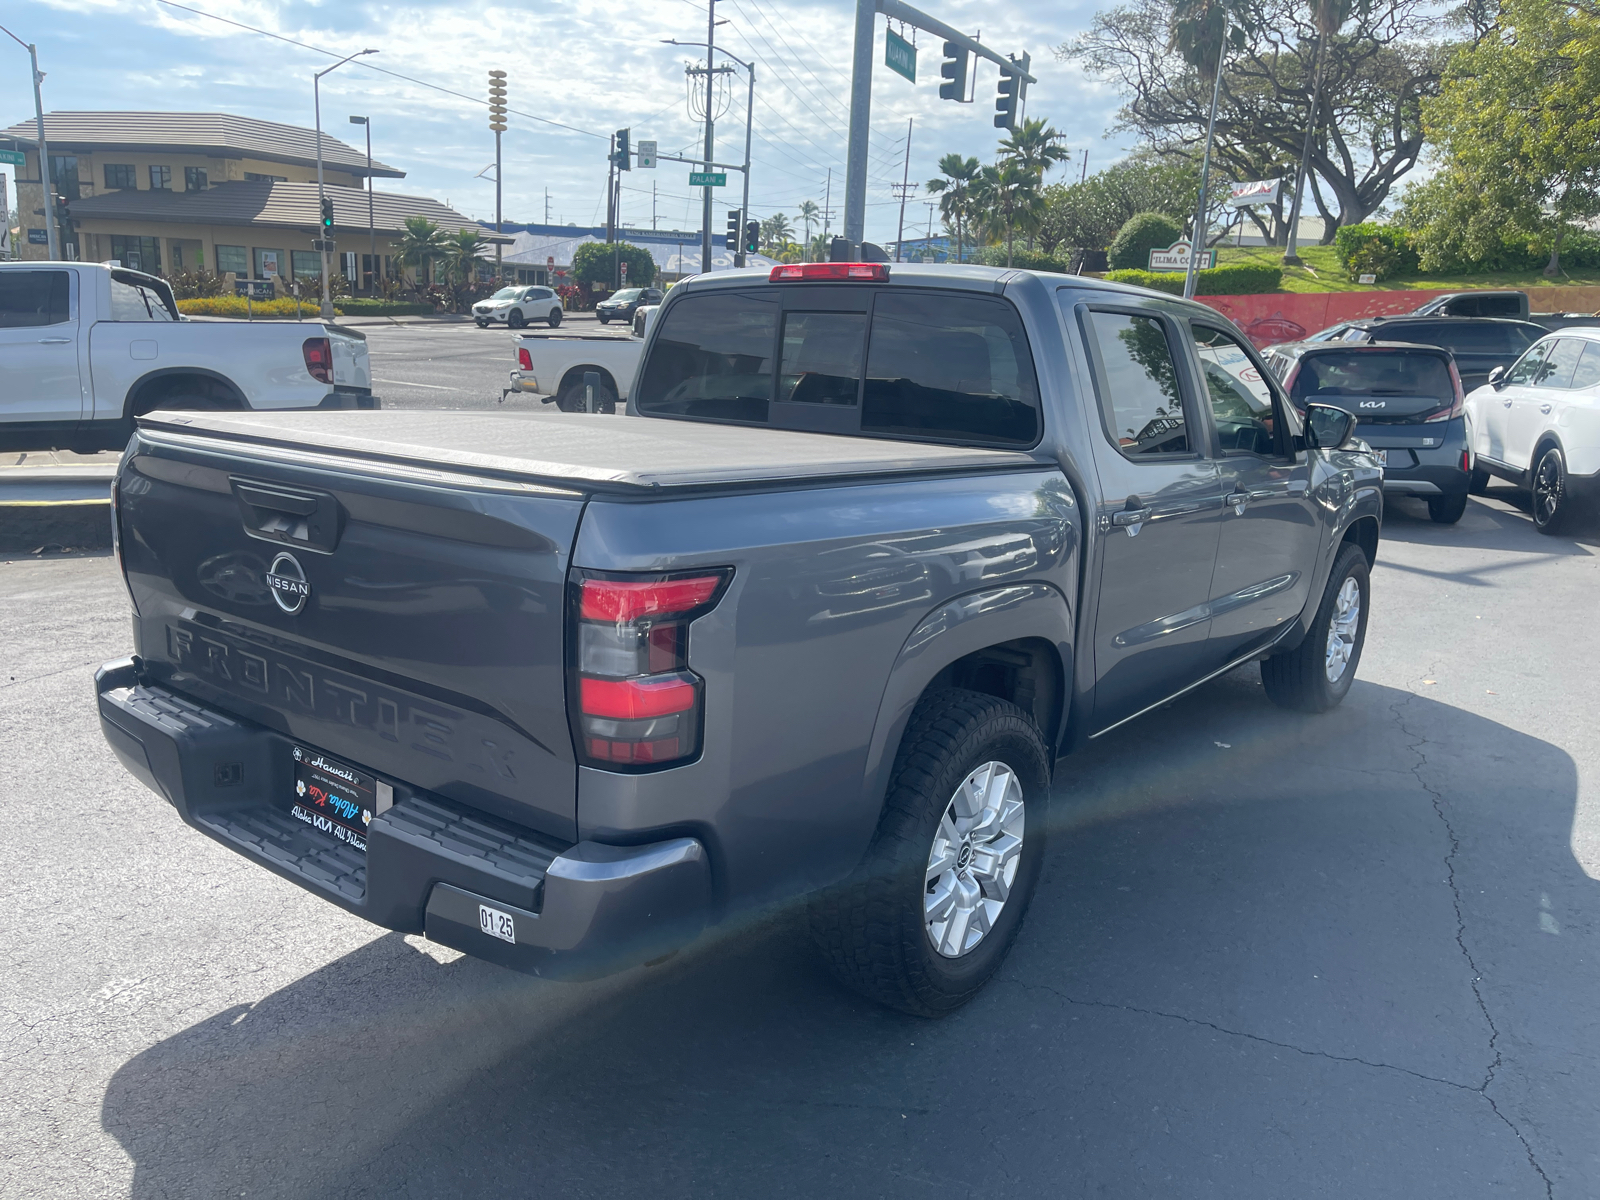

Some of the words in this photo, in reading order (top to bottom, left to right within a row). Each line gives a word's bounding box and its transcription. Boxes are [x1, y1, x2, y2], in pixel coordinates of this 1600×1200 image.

[692, 175, 716, 183] PALANI
[266, 574, 308, 596] NISSAN
[165, 623, 517, 780] FRONTIER
[311, 757, 353, 781] Hawaii
[309, 785, 328, 807] Kia
[329, 794, 359, 819] Aloha
[291, 806, 312, 824] Aloha
[334, 826, 345, 840] All
[481, 909, 494, 931] 01
[499, 915, 513, 938] 25
